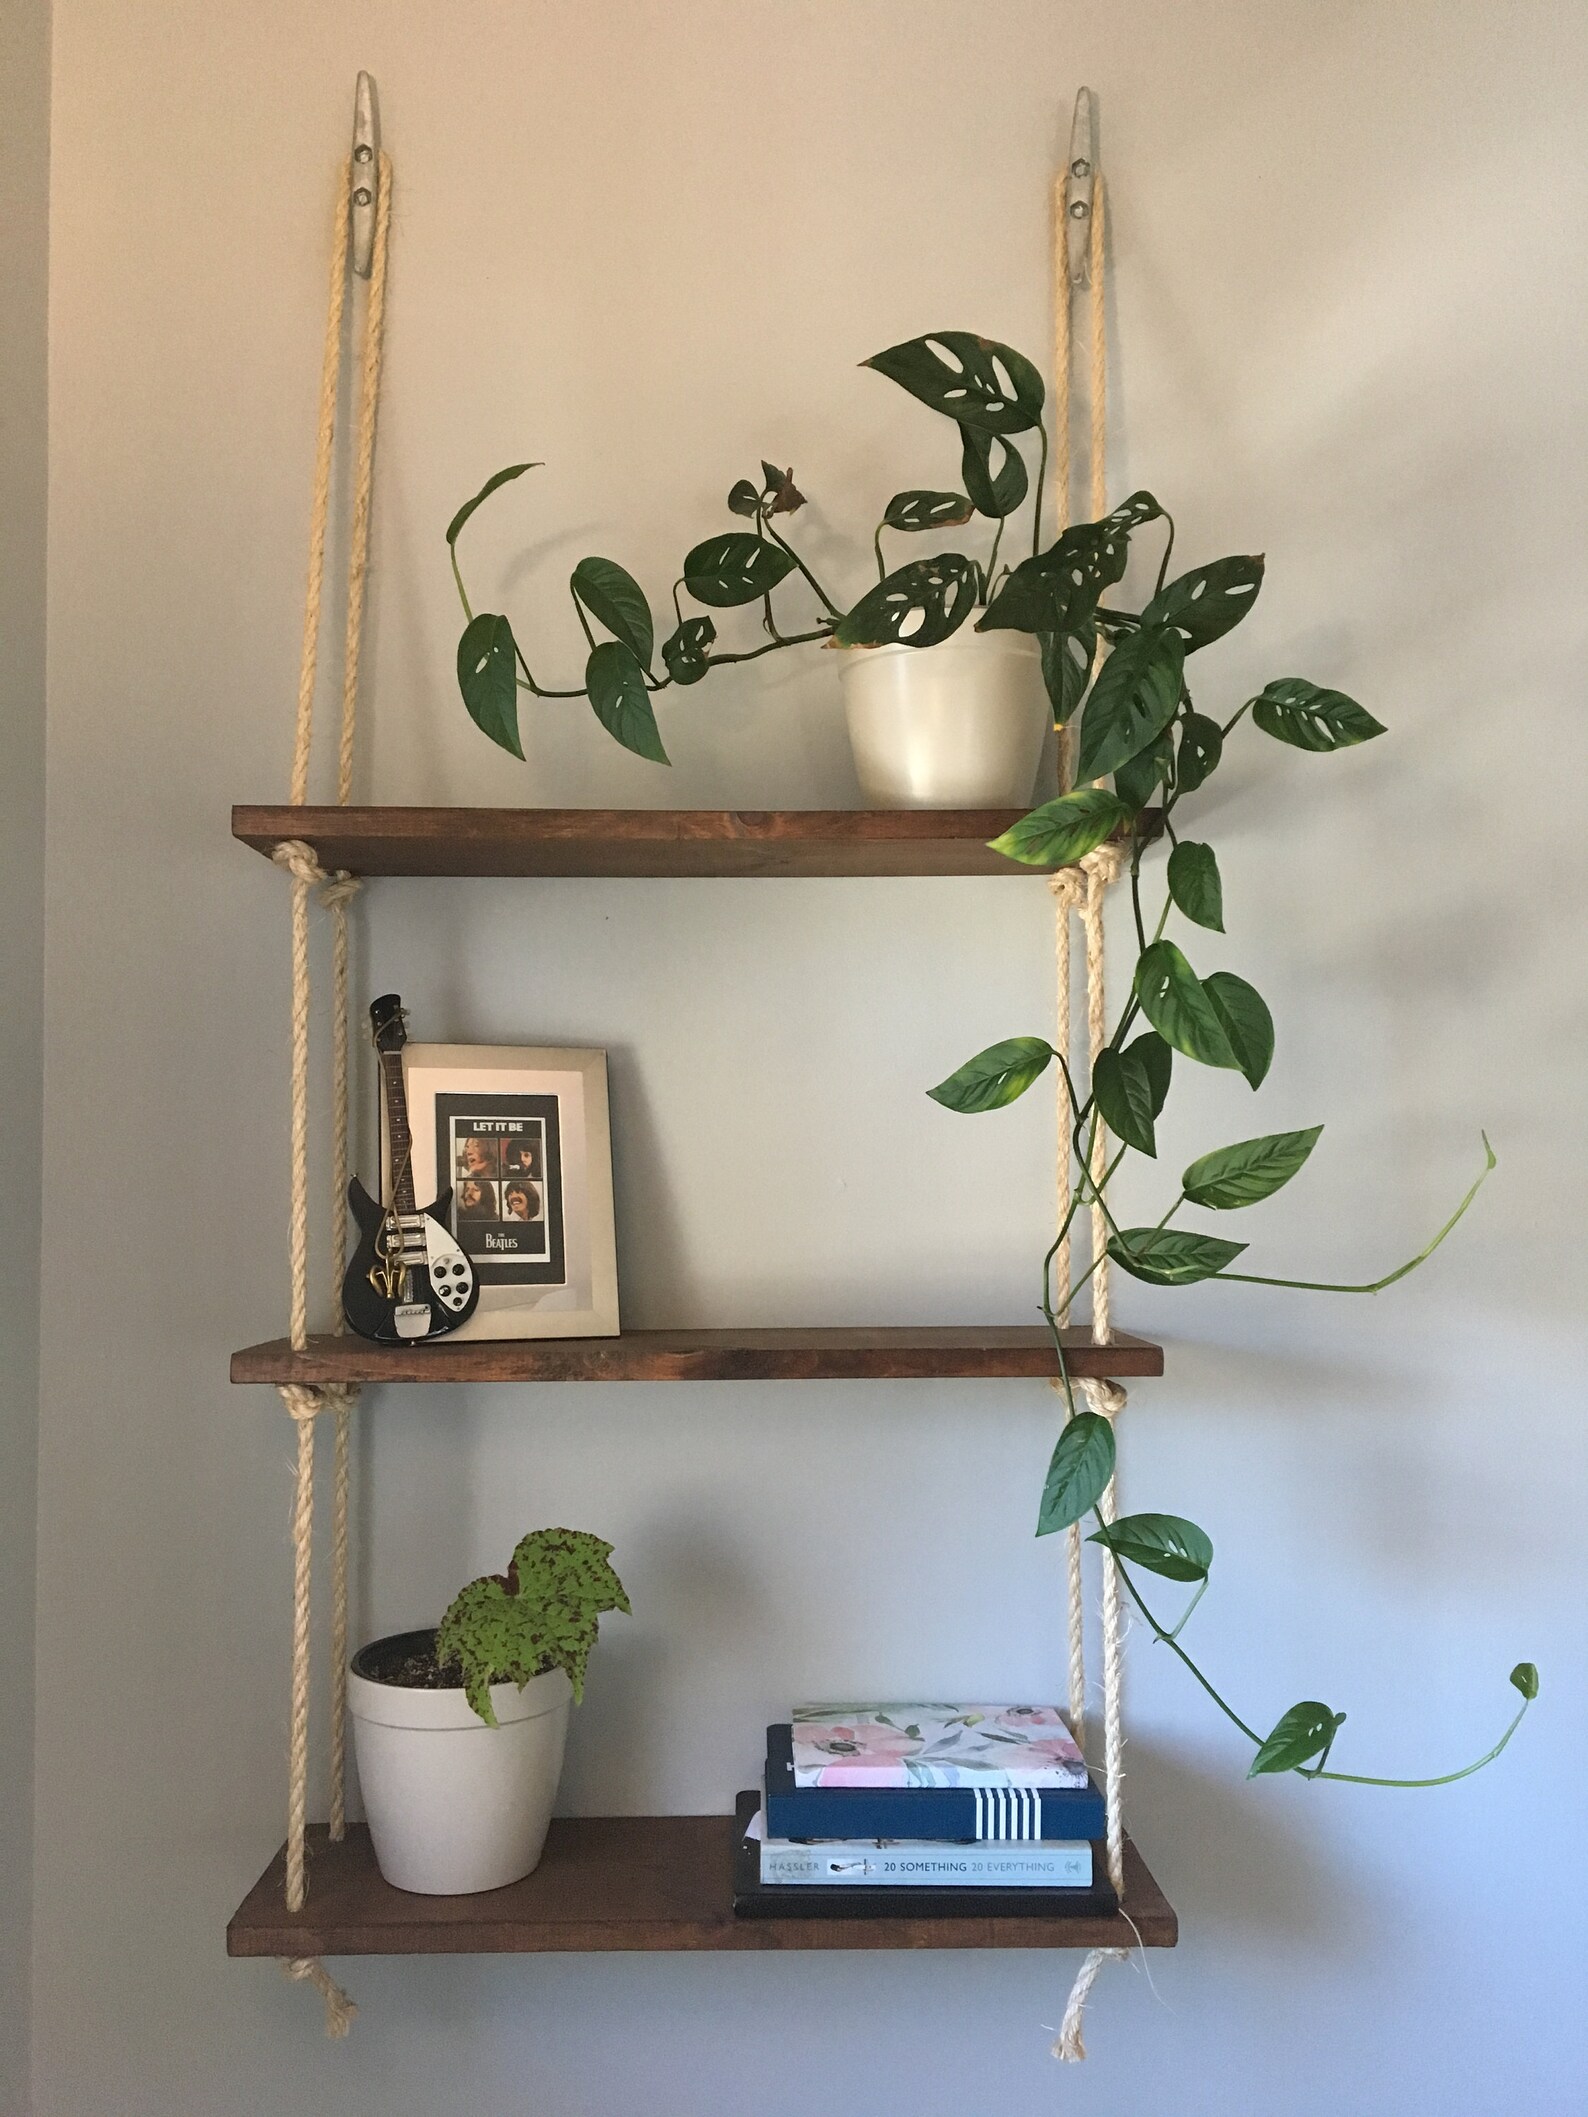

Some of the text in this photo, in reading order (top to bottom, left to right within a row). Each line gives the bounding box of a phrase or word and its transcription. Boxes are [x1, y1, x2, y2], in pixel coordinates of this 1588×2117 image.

[473, 1122, 523, 1131] LET IT BE
[485, 1233, 518, 1250] BEATLES
[769, 1862, 1055, 1872] HASSLER 20 SOMETHING 20 EVERYTHING
